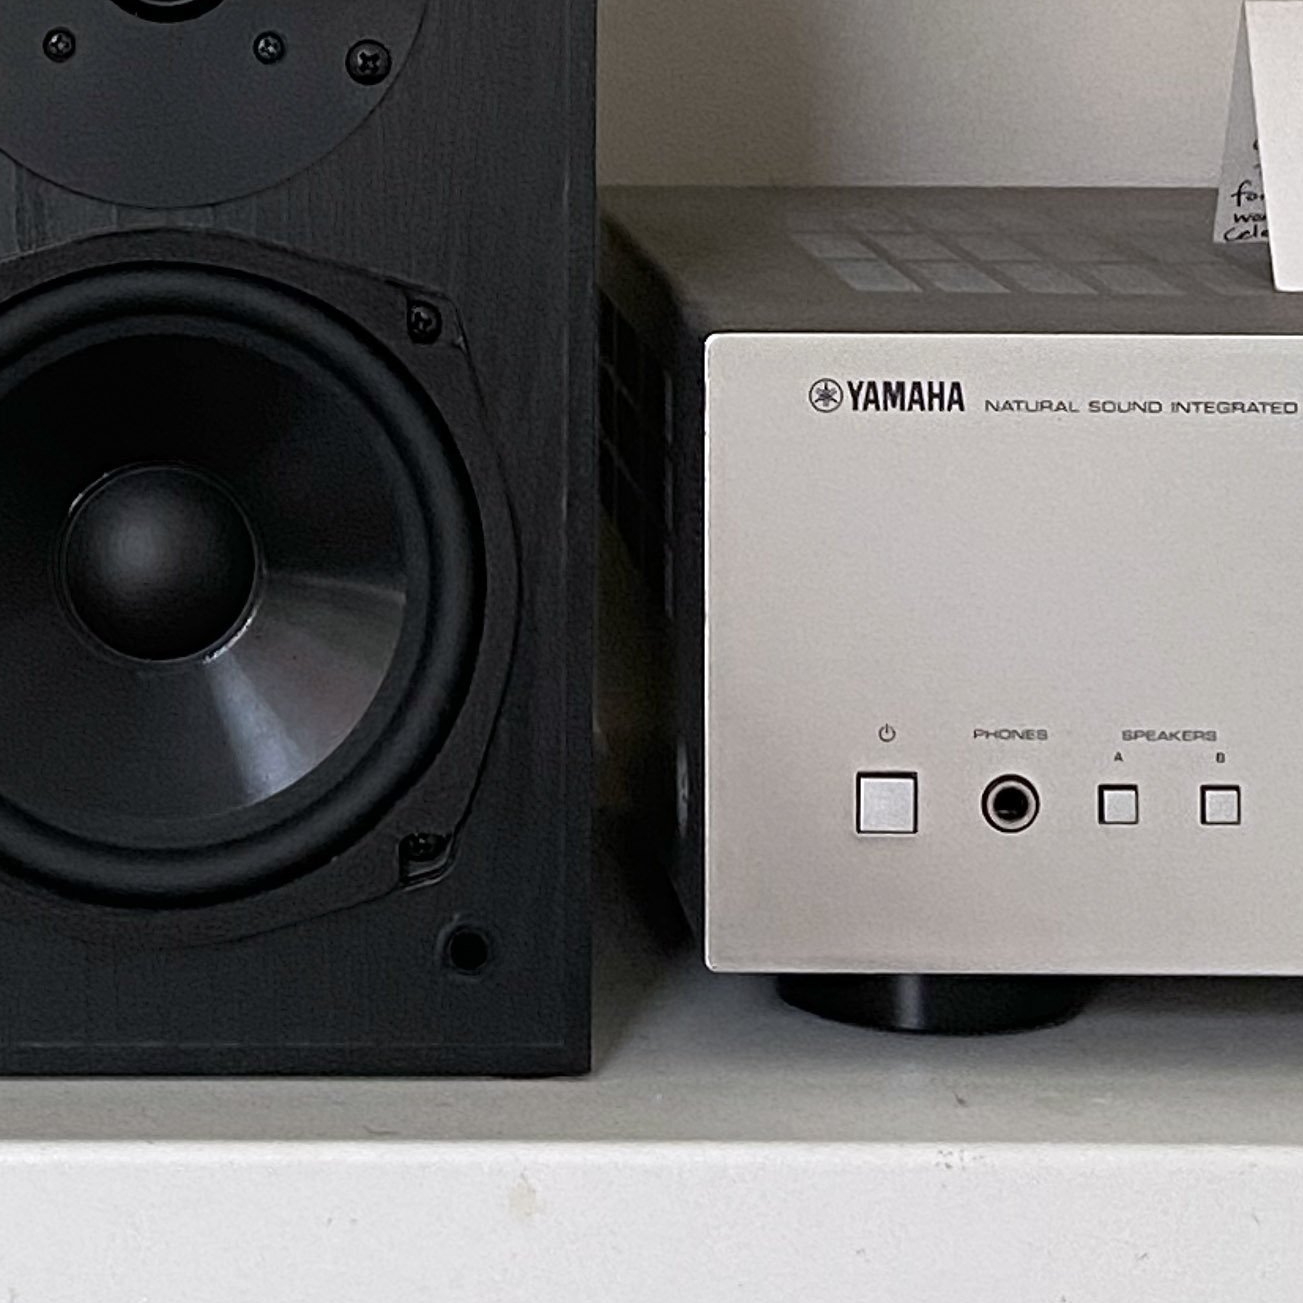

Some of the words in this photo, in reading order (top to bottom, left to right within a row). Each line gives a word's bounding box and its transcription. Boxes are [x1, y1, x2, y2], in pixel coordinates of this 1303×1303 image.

[846, 380, 965, 412] YAMAHA
[984, 399, 1080, 414] NATURAL
[1088, 399, 1163, 414] SOUND
[1171, 400, 1299, 415] INTEGRATED
[973, 728, 1048, 741] PHONES
[1121, 729, 1218, 742] SPEAKERS
[1113, 751, 1124, 762] A
